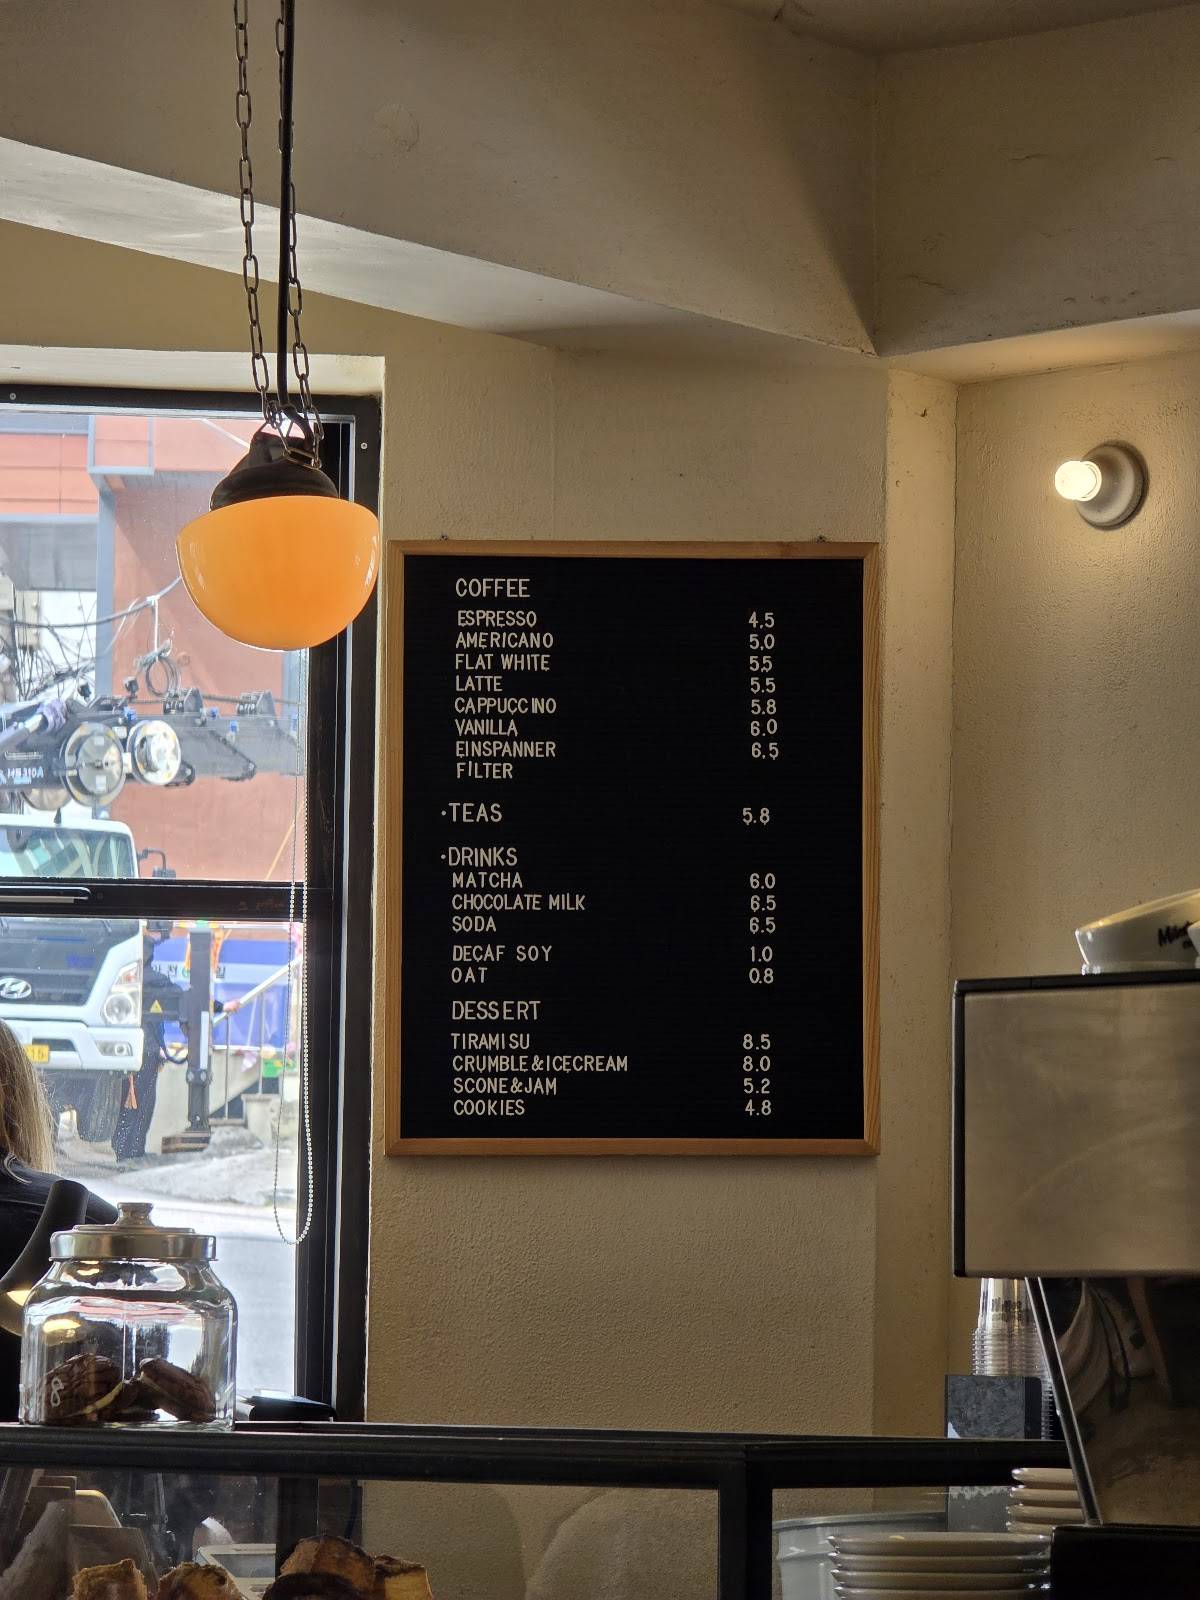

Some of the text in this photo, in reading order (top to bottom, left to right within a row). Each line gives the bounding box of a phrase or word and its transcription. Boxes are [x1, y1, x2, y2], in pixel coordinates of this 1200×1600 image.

[455, 577, 531, 598] COFFEE
[457, 609, 775, 629] ESPRESSO 4.5
[455, 631, 775, 651] AMERICANO 5.0
[455, 653, 773, 673] FLAT WHITE 5.5
[455, 674, 776, 695] LATTE 5.5
[454, 697, 777, 715] CAPPUCCINO 5.8
[454, 718, 778, 737] VANILLA 6.0
[455, 740, 779, 761] EINSPANNER 6.5
[456, 760, 513, 779] FILTER
[742, 807, 770, 826] 5.8
[452, 871, 776, 890] MATCHA 6.0
[451, 892, 777, 913] CHOCOLATE MILK 6.5
[452, 915, 776, 935] SODA 6.5
[452, 943, 773, 963] DECAF SOY 1.0
[451, 966, 774, 984] OAT 0.8
[452, 1000, 541, 1020] DESSERT
[450, 1032, 771, 1051] TIRAMISU 8.5
[742, 1055, 771, 1072] 8.0
[743, 1077, 771, 1094] 5.2
[453, 1098, 772, 1116] COOKIES 4.8
